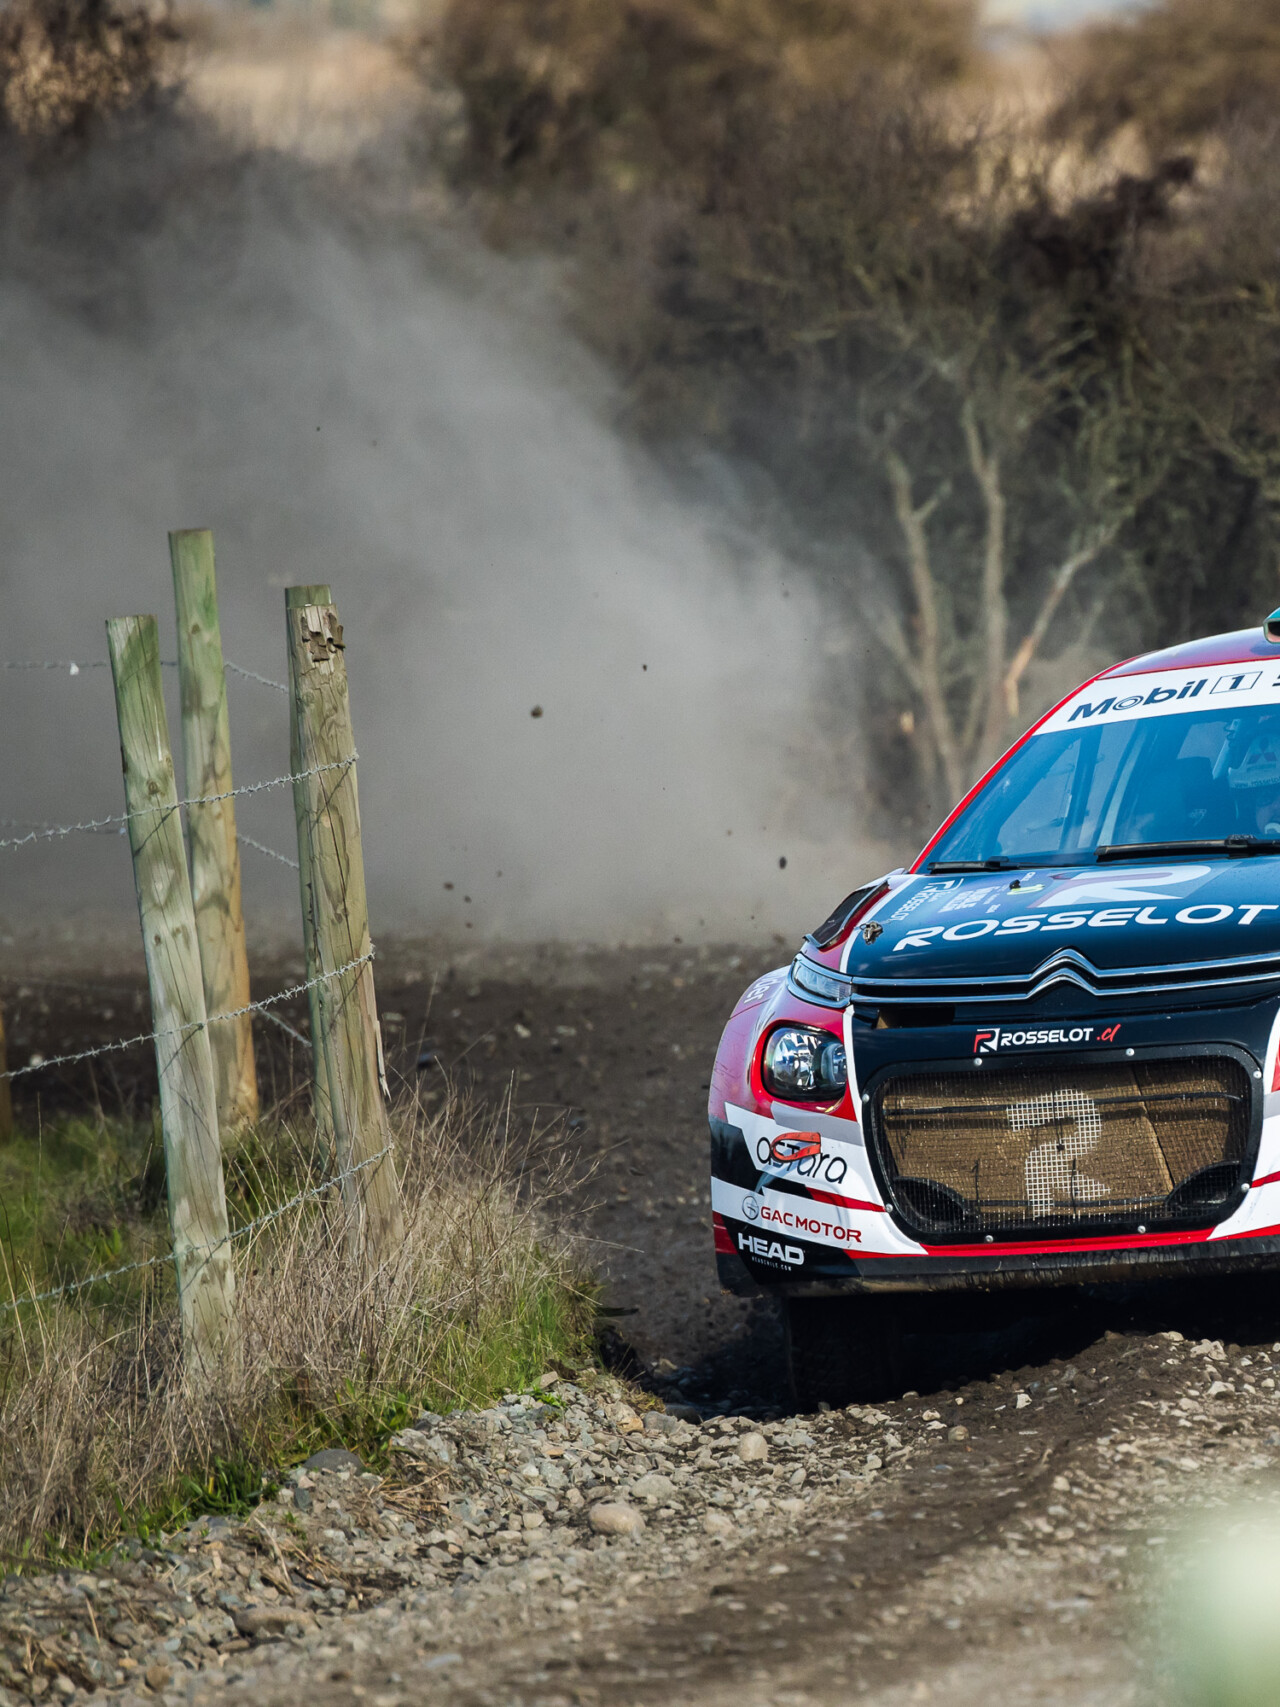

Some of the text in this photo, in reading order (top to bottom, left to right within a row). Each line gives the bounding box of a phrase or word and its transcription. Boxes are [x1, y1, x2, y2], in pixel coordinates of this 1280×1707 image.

[1067, 679, 1208, 722] Mobil
[892, 904, 1280, 952] ROSSELOT
[1000, 1028, 1094, 1047] ROSSELOT
[761, 1206, 862, 1244] GAC MOTOR
[738, 1233, 805, 1266] HEAD
